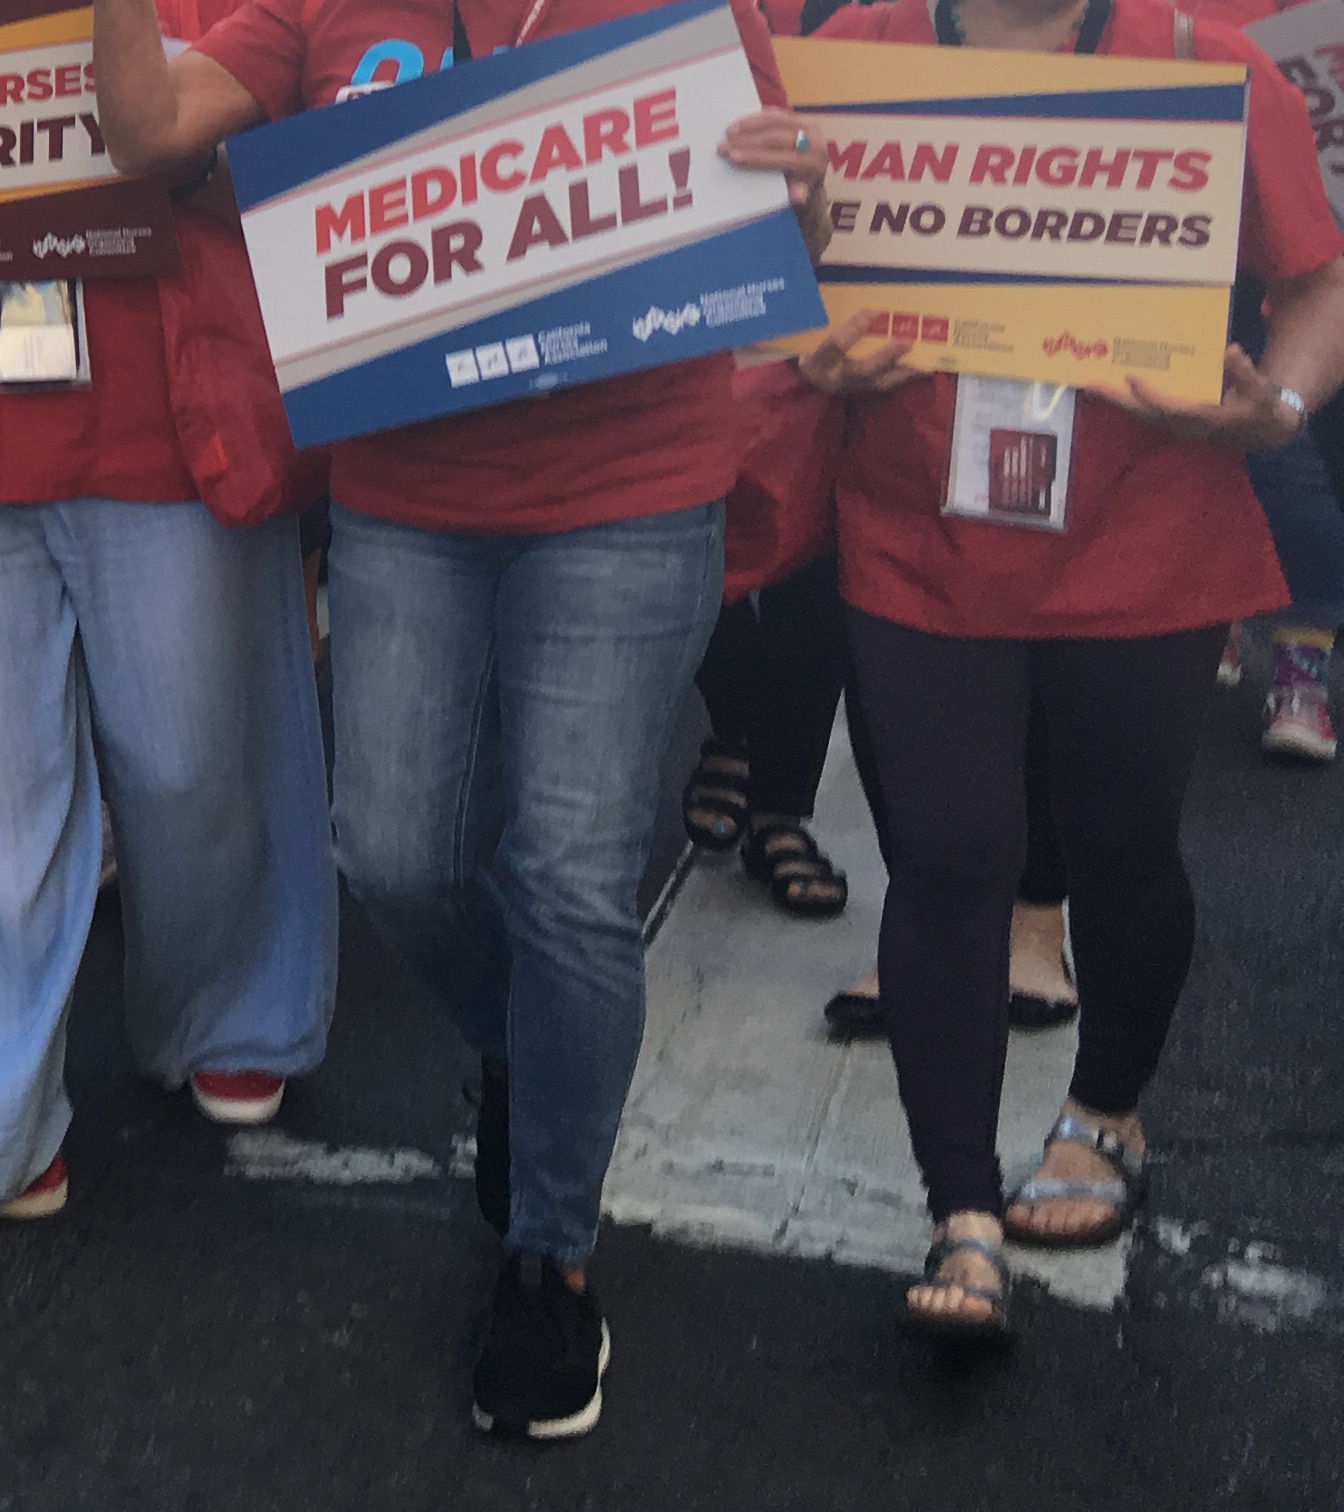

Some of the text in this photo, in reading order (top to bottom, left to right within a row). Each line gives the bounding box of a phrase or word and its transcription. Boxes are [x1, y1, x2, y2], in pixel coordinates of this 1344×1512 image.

[315, 86, 680, 257] MEDICARE
[827, 140, 1213, 192] MAN RIGHTS
[325, 145, 694, 322] FOR ALL!
[869, 202, 946, 236] NO
[957, 205, 1213, 248] BORDERS
